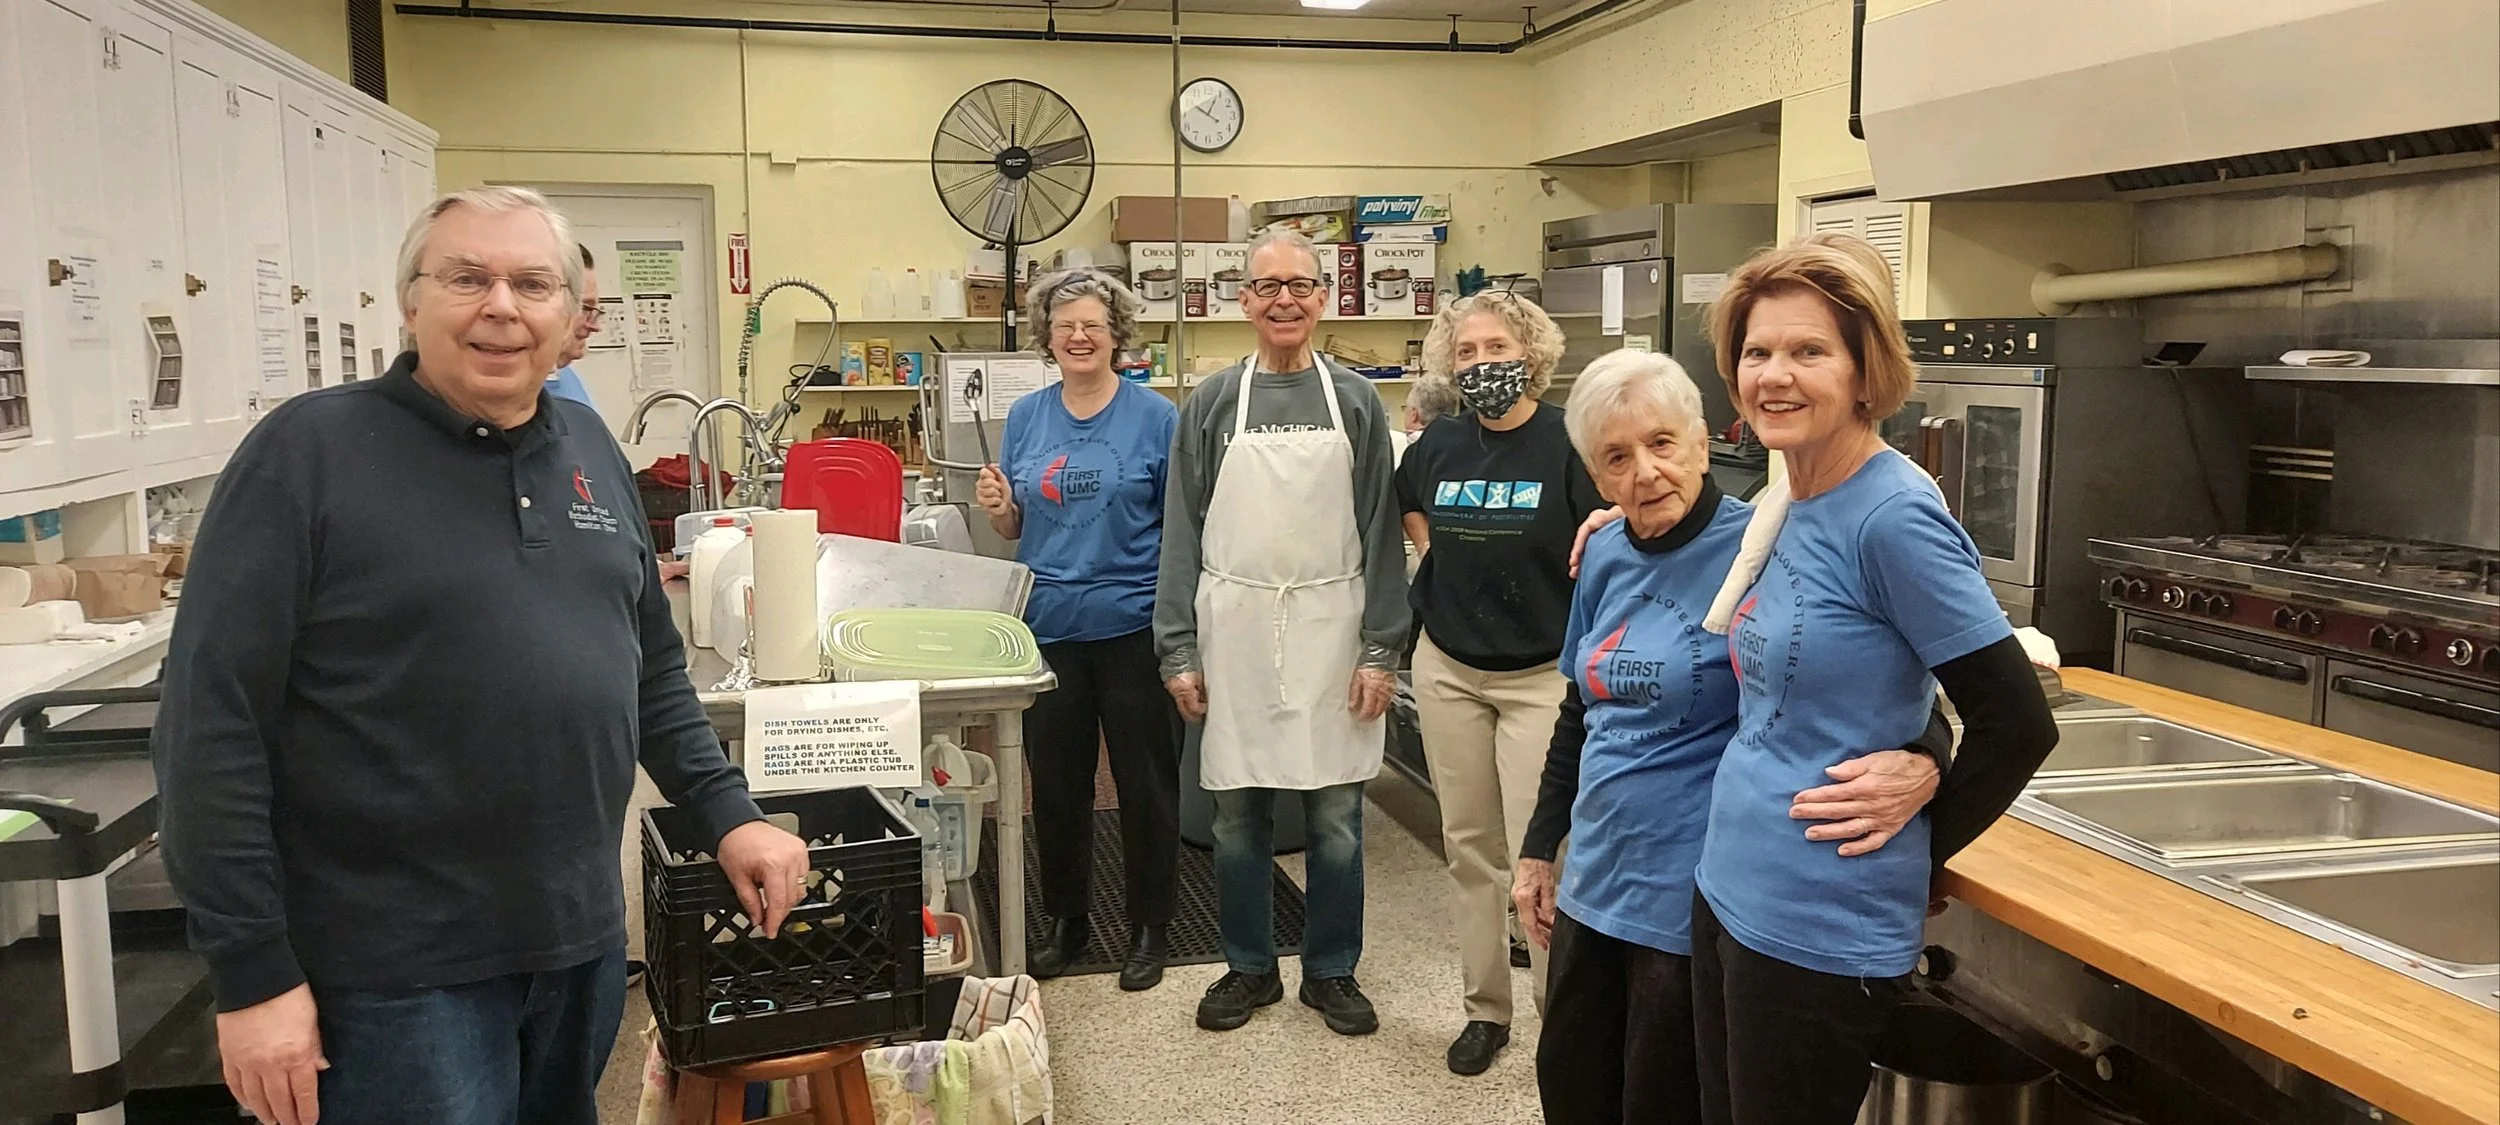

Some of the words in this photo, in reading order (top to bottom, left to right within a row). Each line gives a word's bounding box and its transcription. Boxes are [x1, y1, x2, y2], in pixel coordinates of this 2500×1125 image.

[1361, 198, 1420, 216] polyvinyl
[731, 238, 746, 247] FIRE
[1067, 469, 1103, 481] FIRST
[1066, 481, 1101, 495] UMC
[1777, 551, 1801, 590] LOVE
[1655, 594, 1689, 623] LOVE
[1784, 595, 1805, 686] OTHERS
[1617, 659, 1666, 678] FIRST
[1616, 680, 1663, 701] UMC
[765, 720, 787, 728] DISH
[791, 719, 829, 727] TOWELS
[787, 727, 823, 735] DRYING
[826, 726, 865, 734] DISHES,
[794, 743, 813, 751] ARE
[816, 742, 835, 750] FOR
[838, 741, 873, 749] WIPING
[765, 752, 797, 760] SPILLS
[817, 750, 868, 758] ANYTHING
[765, 760, 790, 768] RAGS
[839, 757, 879, 765] PLASTIC
[882, 756, 901, 764] TUB
[764, 768, 798, 777] UNDER
[800, 767, 820, 775] THE
[823, 765, 866, 774] KITCHEN
[869, 764, 915, 772] COUNTER
